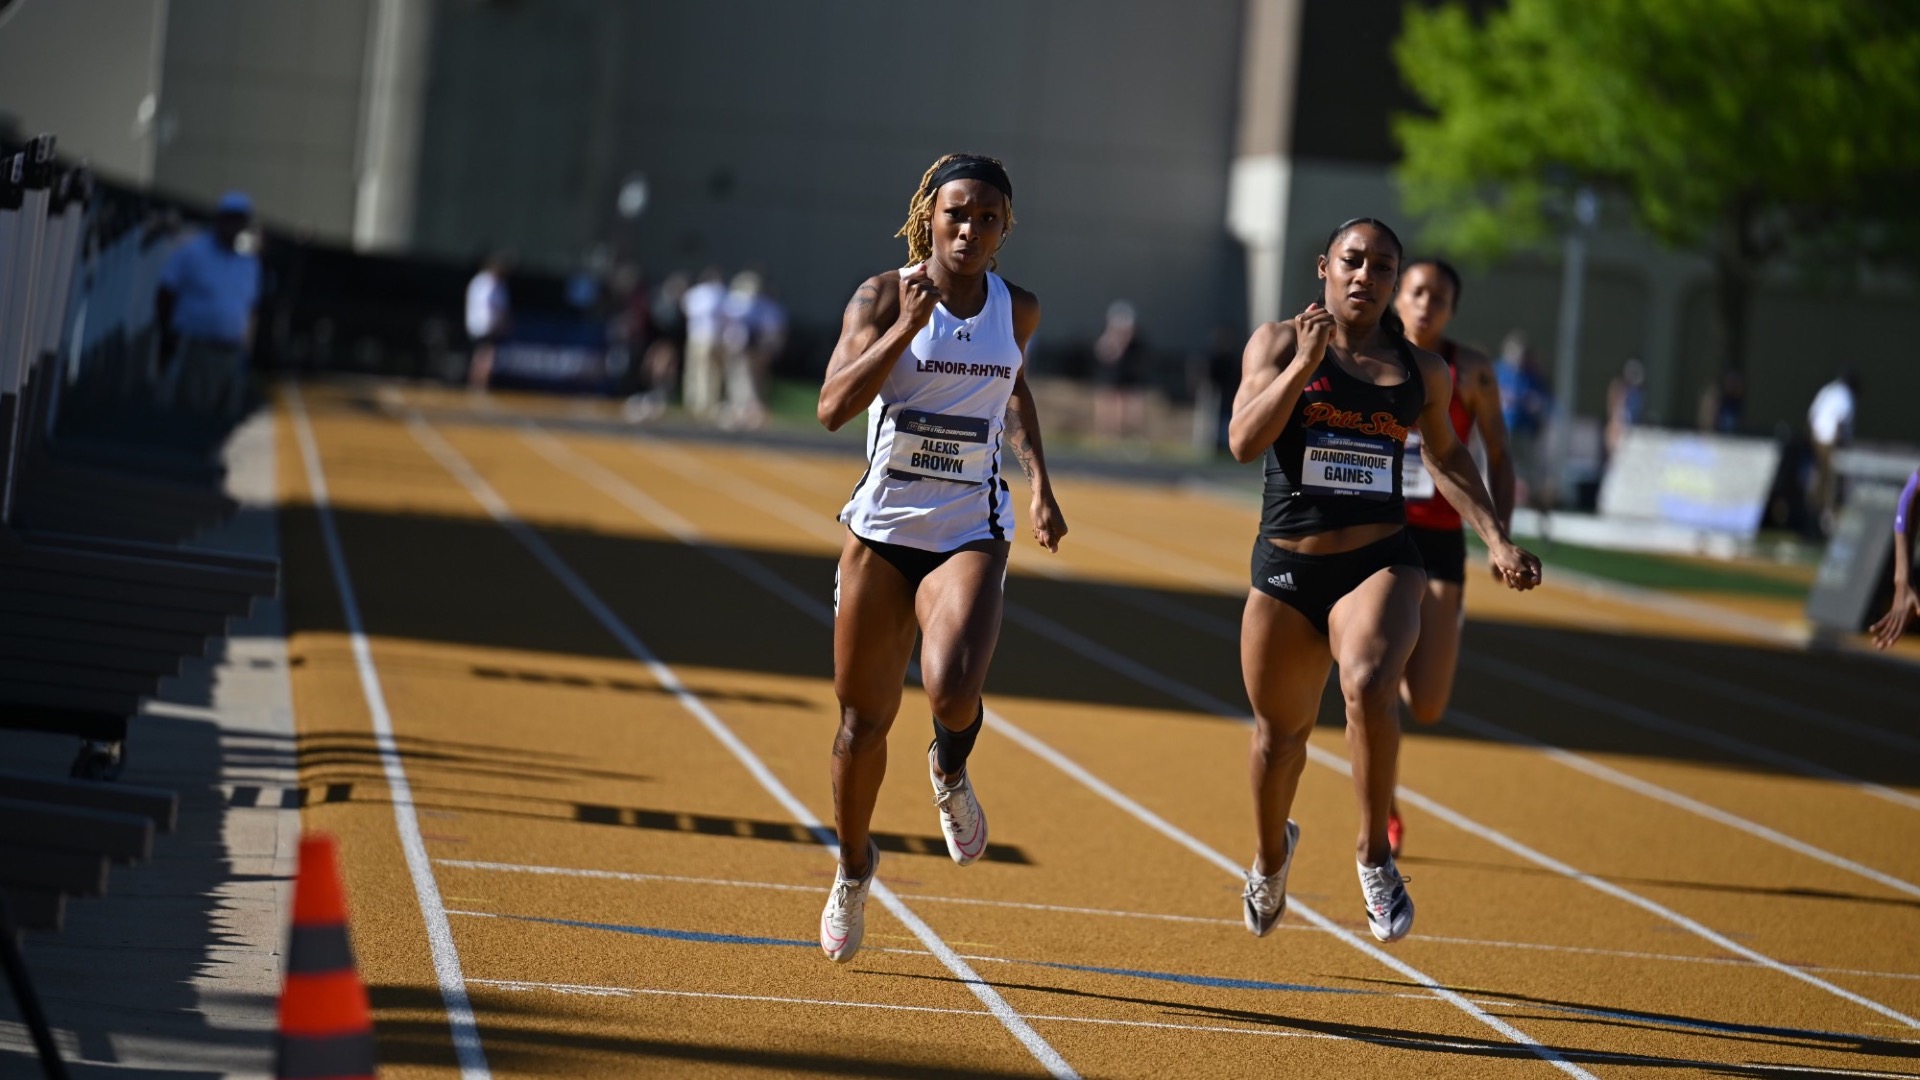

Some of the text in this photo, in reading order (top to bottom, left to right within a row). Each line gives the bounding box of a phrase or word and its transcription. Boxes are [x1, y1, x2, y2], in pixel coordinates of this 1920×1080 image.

[916, 360, 1011, 379] LENOIR-RHYNE
[1303, 402, 1362, 428] Pitt
[921, 439, 960, 455] ALEXIS
[911, 453, 964, 473] BROWN
[1310, 450, 1387, 470] DIANDRENIQUE
[1324, 466, 1373, 485] GAINES
[1267, 577, 1297, 591] adidas
